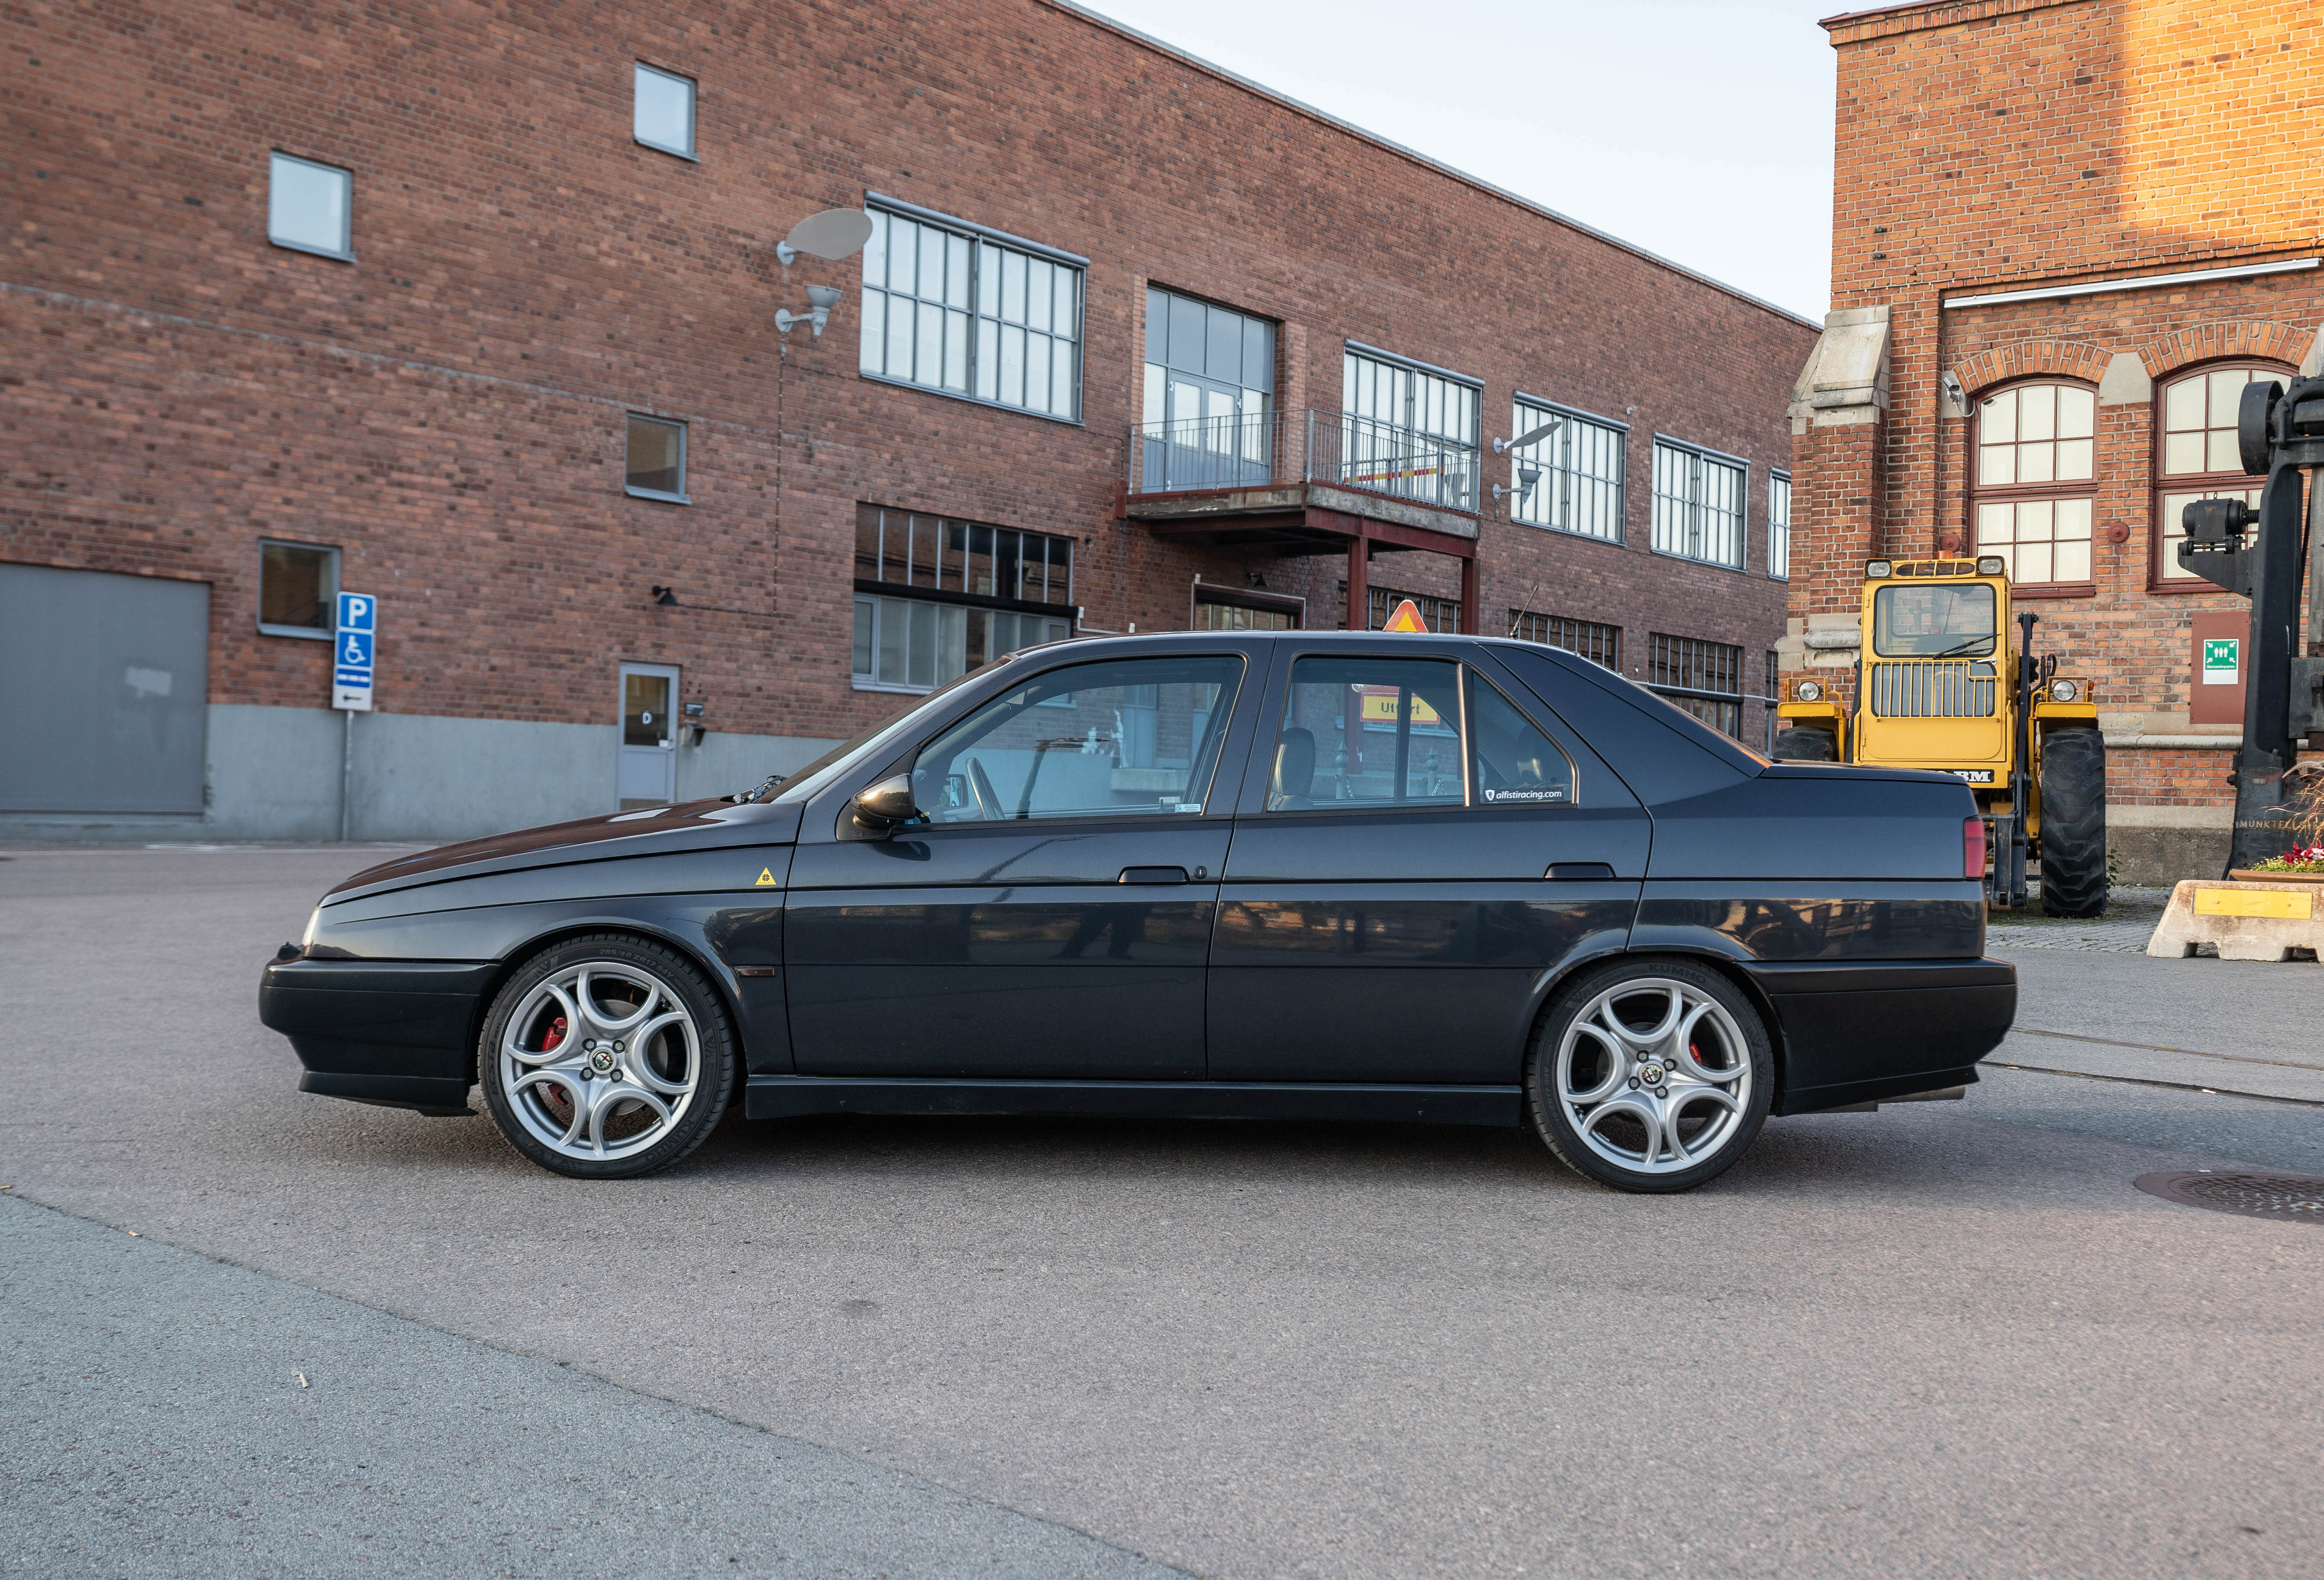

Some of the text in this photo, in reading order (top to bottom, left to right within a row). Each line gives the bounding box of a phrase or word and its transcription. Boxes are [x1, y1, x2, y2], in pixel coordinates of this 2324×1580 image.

[348, 598, 368, 627] P
[1381, 702, 1420, 714] Utrt
[642, 712, 652, 725] D
[1953, 771, 1990, 782] BM
[1496, 790, 1562, 799] alfistiracing.com
[598, 949, 632, 958] 205/40
[633, 954, 657, 967] ZR17
[1649, 963, 1706, 984] KUMHO
[645, 1120, 696, 1161] KUMHO
